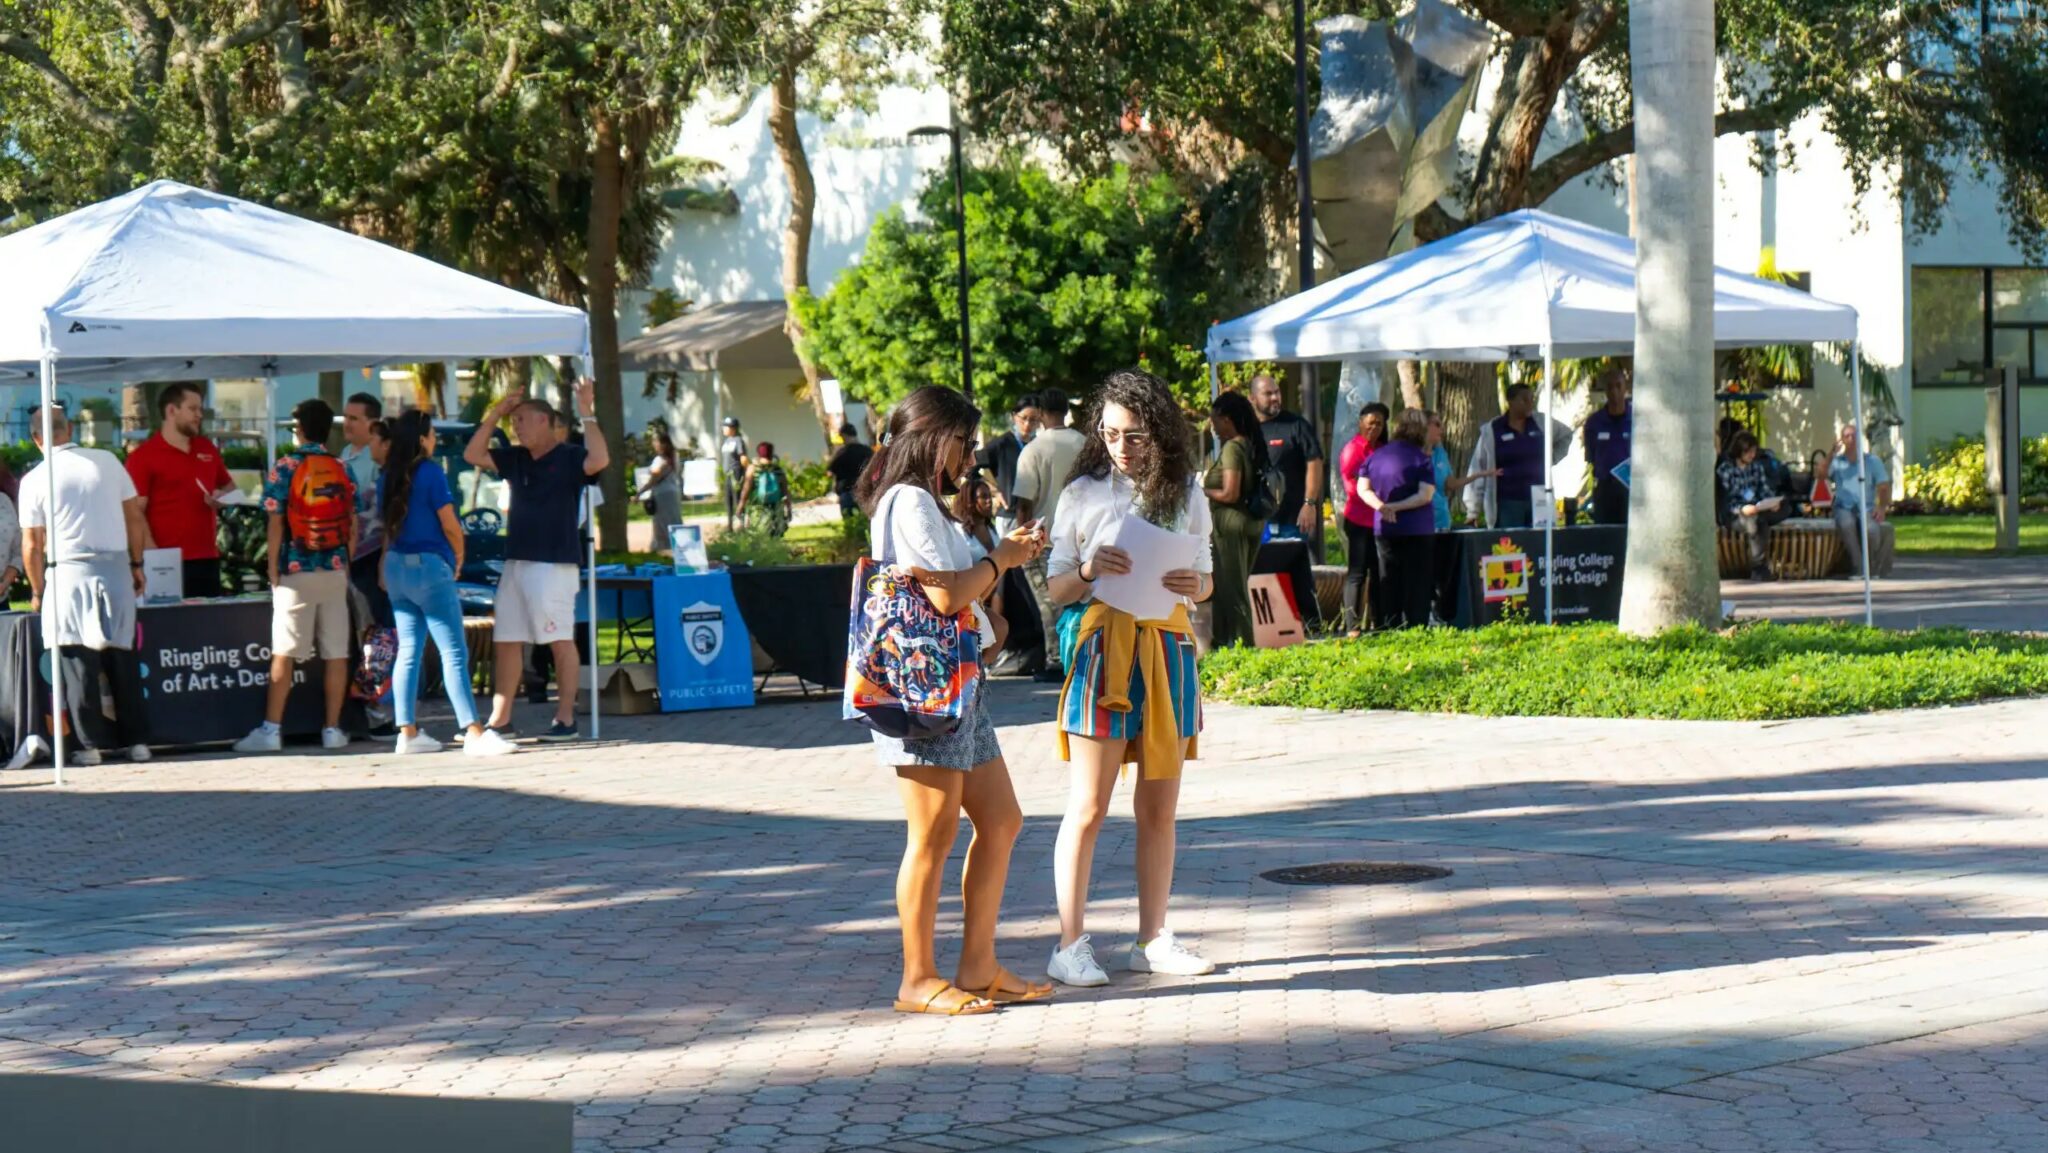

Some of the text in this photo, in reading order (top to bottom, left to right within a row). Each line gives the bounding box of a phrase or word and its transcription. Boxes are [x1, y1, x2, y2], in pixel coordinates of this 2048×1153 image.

[1578, 553, 1614, 569] College
[1574, 570, 1607, 586] Design
[159, 646, 241, 670] Ringling
[162, 672, 182, 693] of
[188, 673, 219, 692] Art
[237, 669, 306, 688] Den
[669, 684, 748, 699] PUBLIC SAFETY
